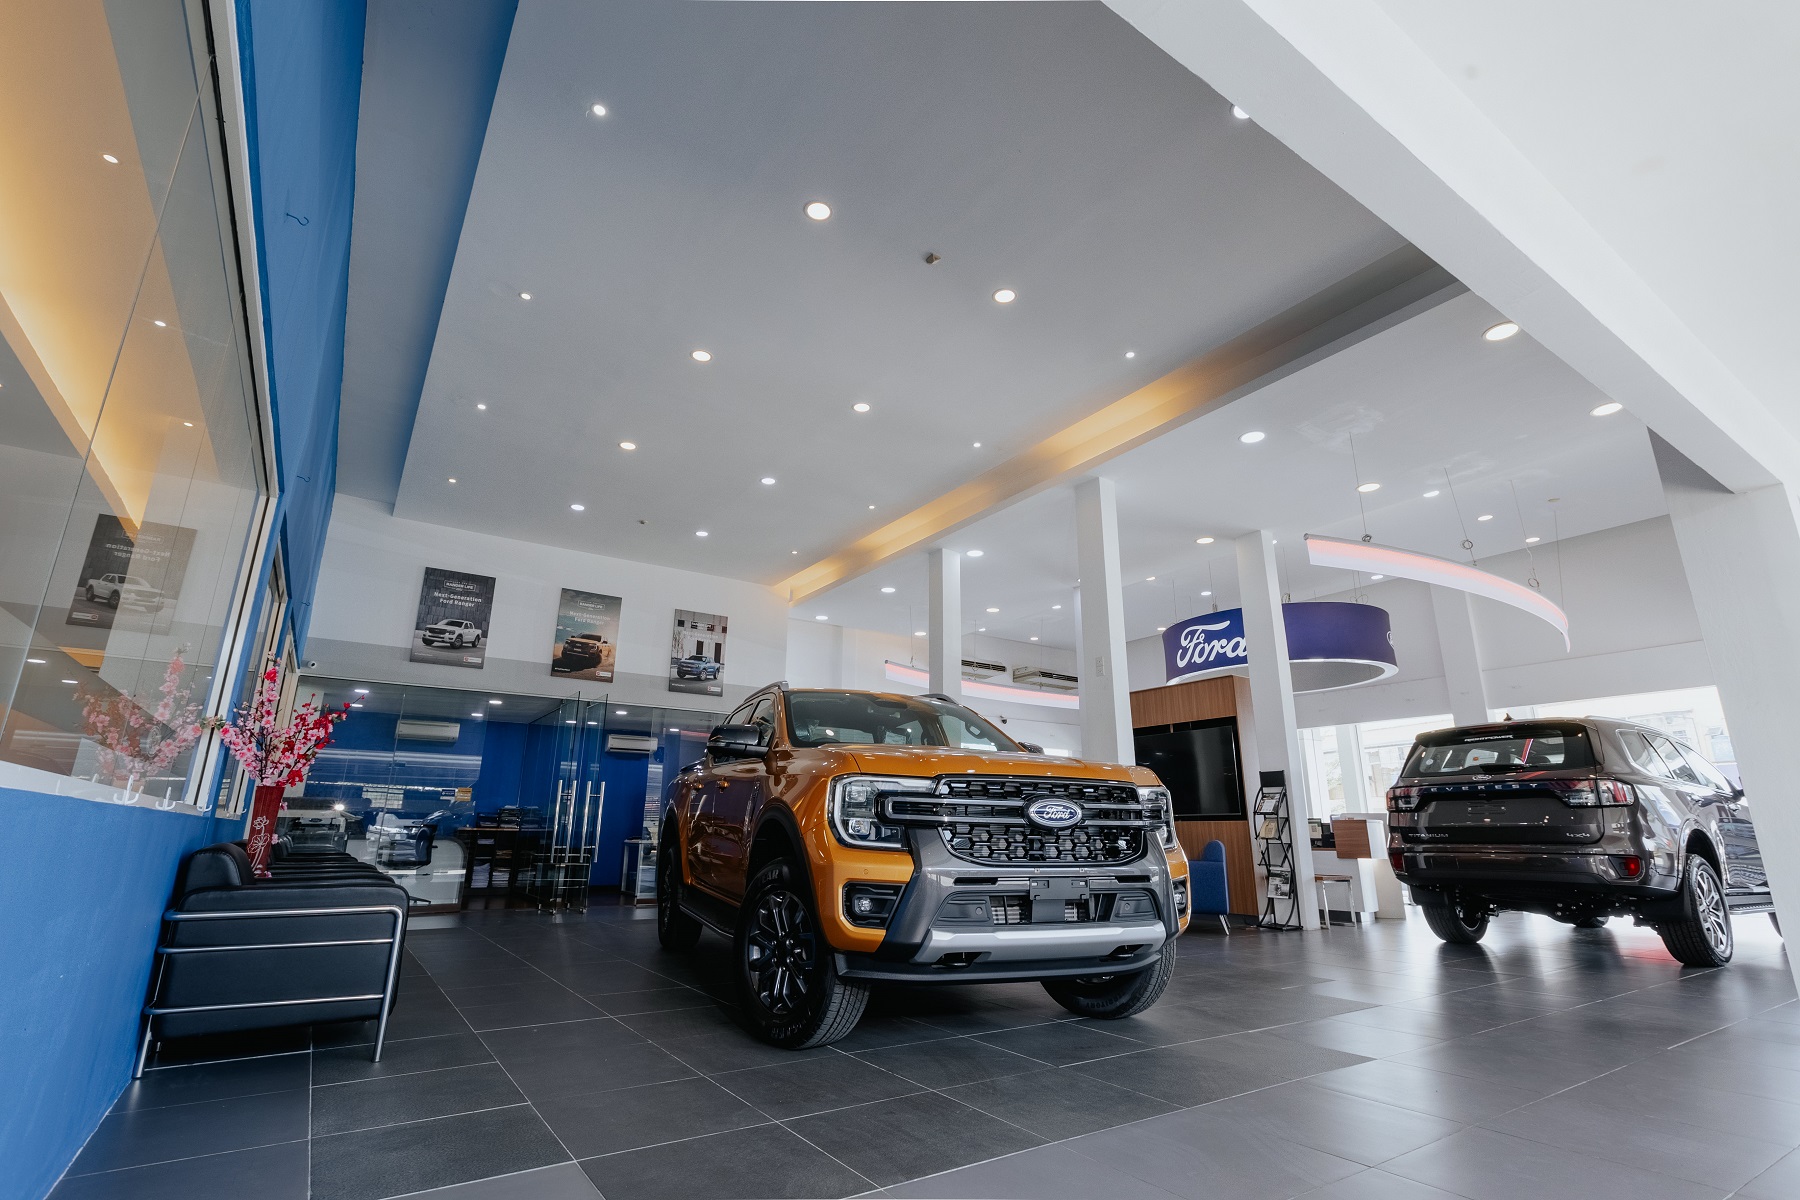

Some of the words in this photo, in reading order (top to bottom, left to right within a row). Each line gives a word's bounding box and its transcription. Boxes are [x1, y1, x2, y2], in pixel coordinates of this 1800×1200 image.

[433, 592, 482, 602] Next-Generation
[1430, 783, 1538, 792] EVEREST
[1043, 805, 1073, 819] Ford
